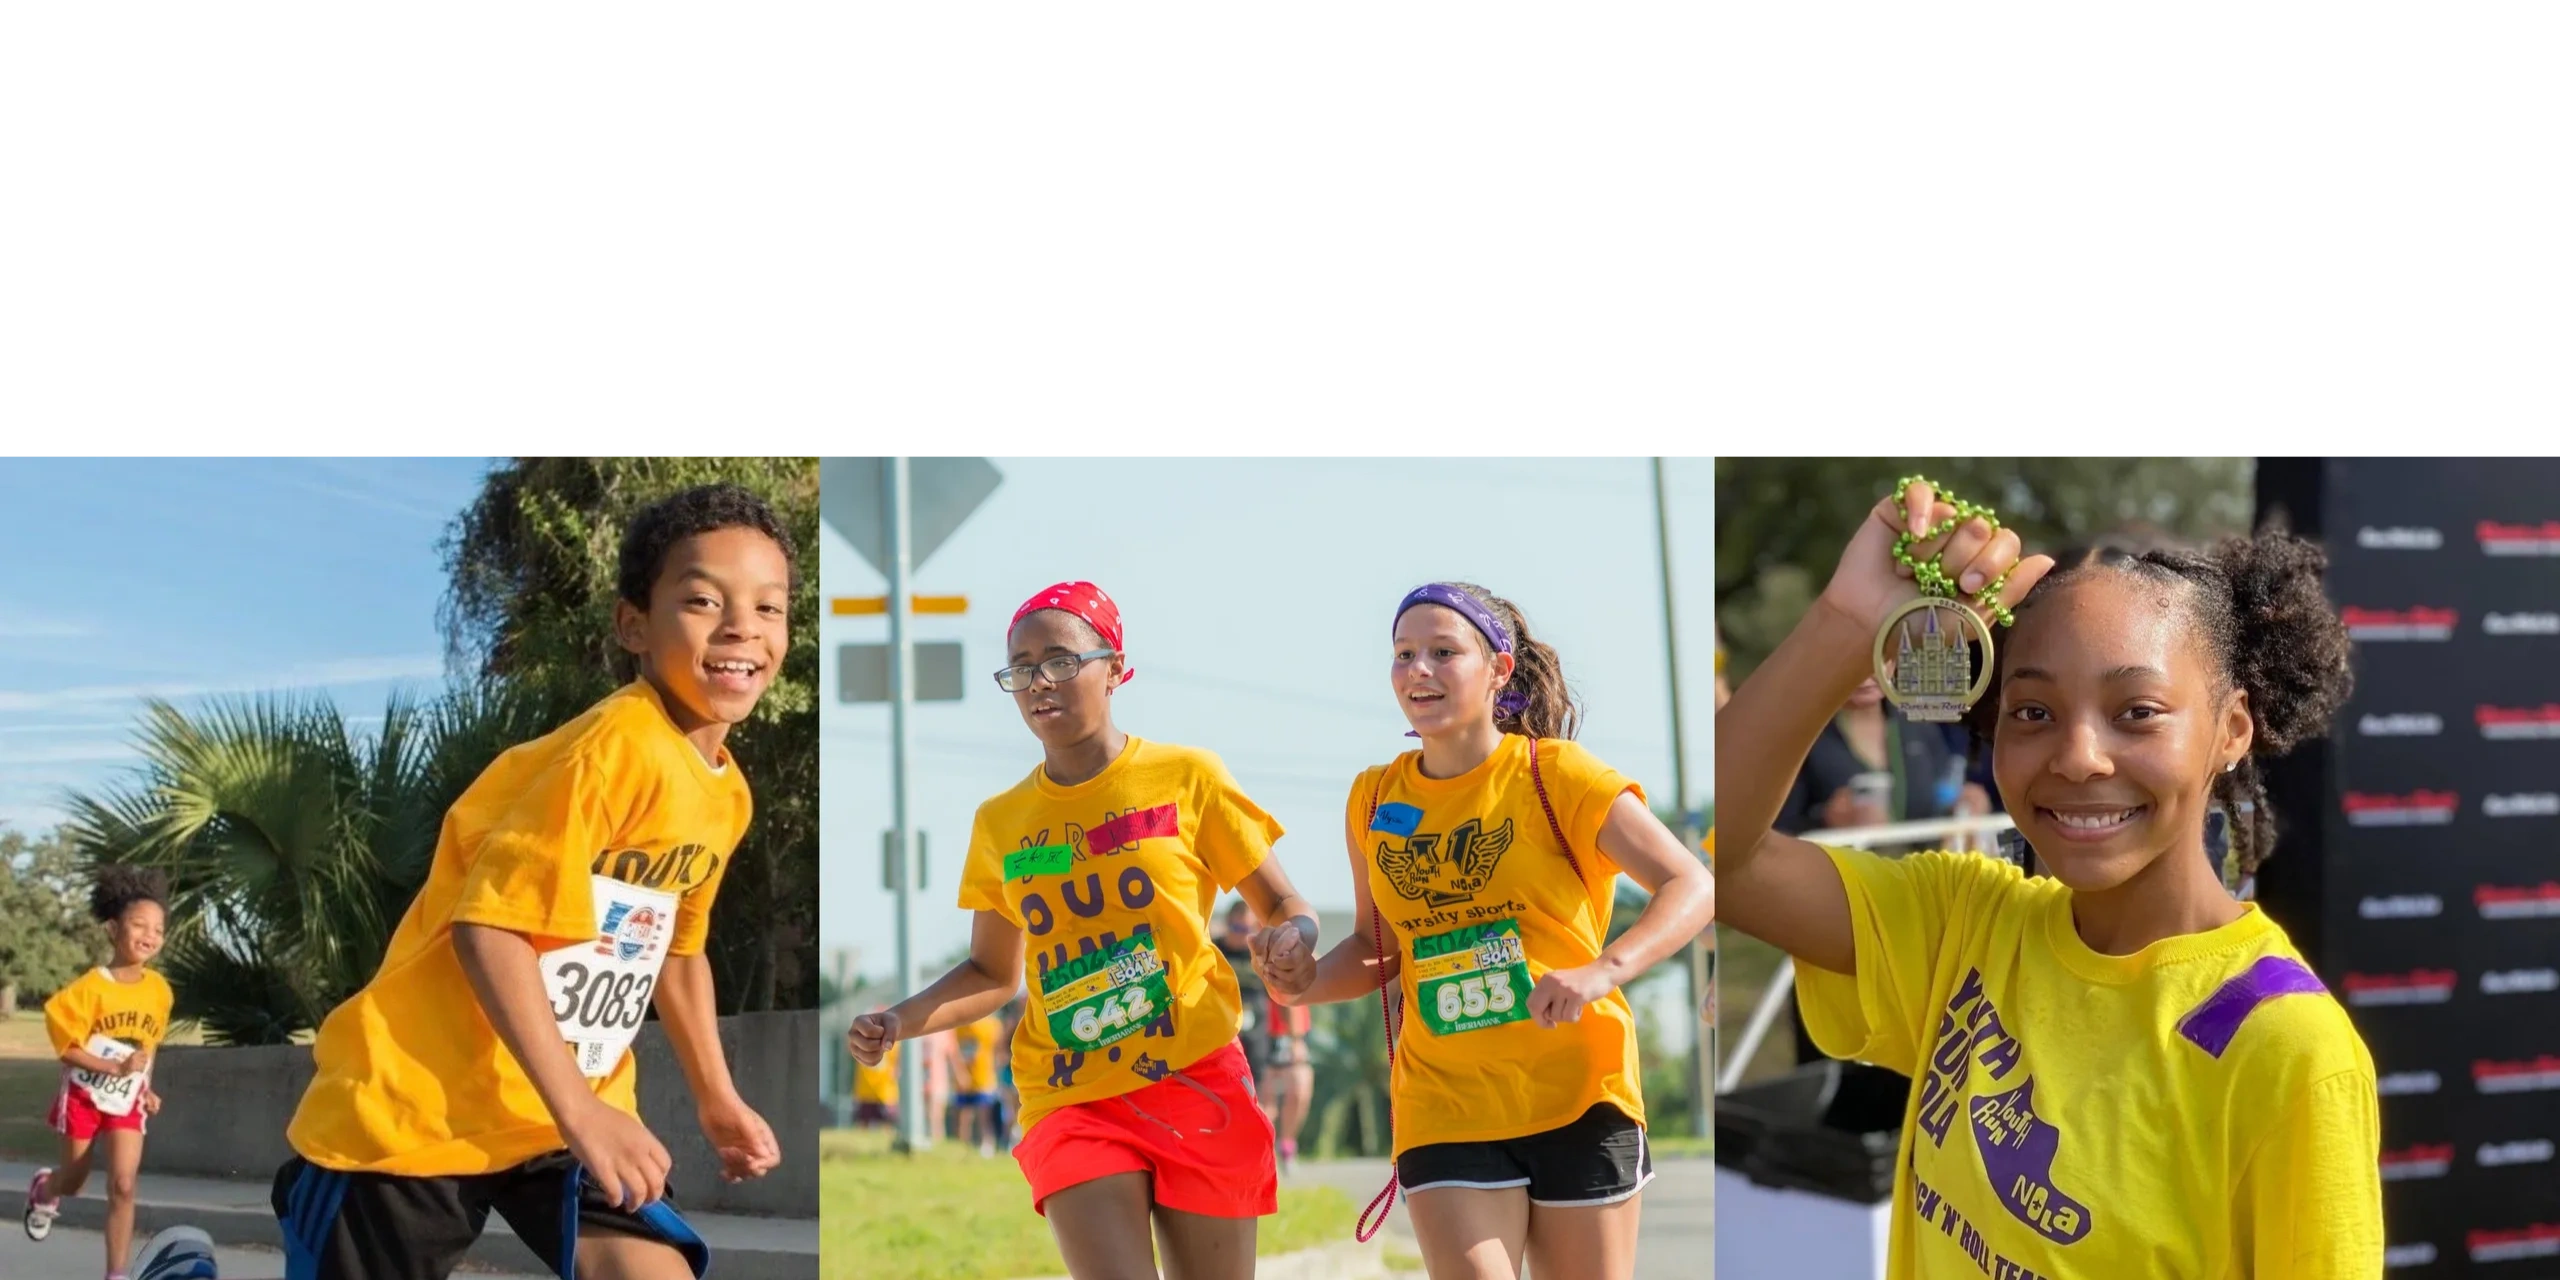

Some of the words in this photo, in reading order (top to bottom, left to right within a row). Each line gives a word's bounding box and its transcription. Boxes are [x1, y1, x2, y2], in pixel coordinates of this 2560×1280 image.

[1409, 871, 1430, 885] RUN
[1415, 864, 1441, 878] YOUTH
[1466, 899, 1527, 919] sports
[550, 961, 653, 1030] 3083
[1071, 986, 1154, 1042] 642
[1437, 971, 1516, 1023] 653
[1972, 1099, 2008, 1147] RUN
[1997, 1089, 2033, 1150] YOUTH
[1959, 1218, 1990, 1277] ROLL
